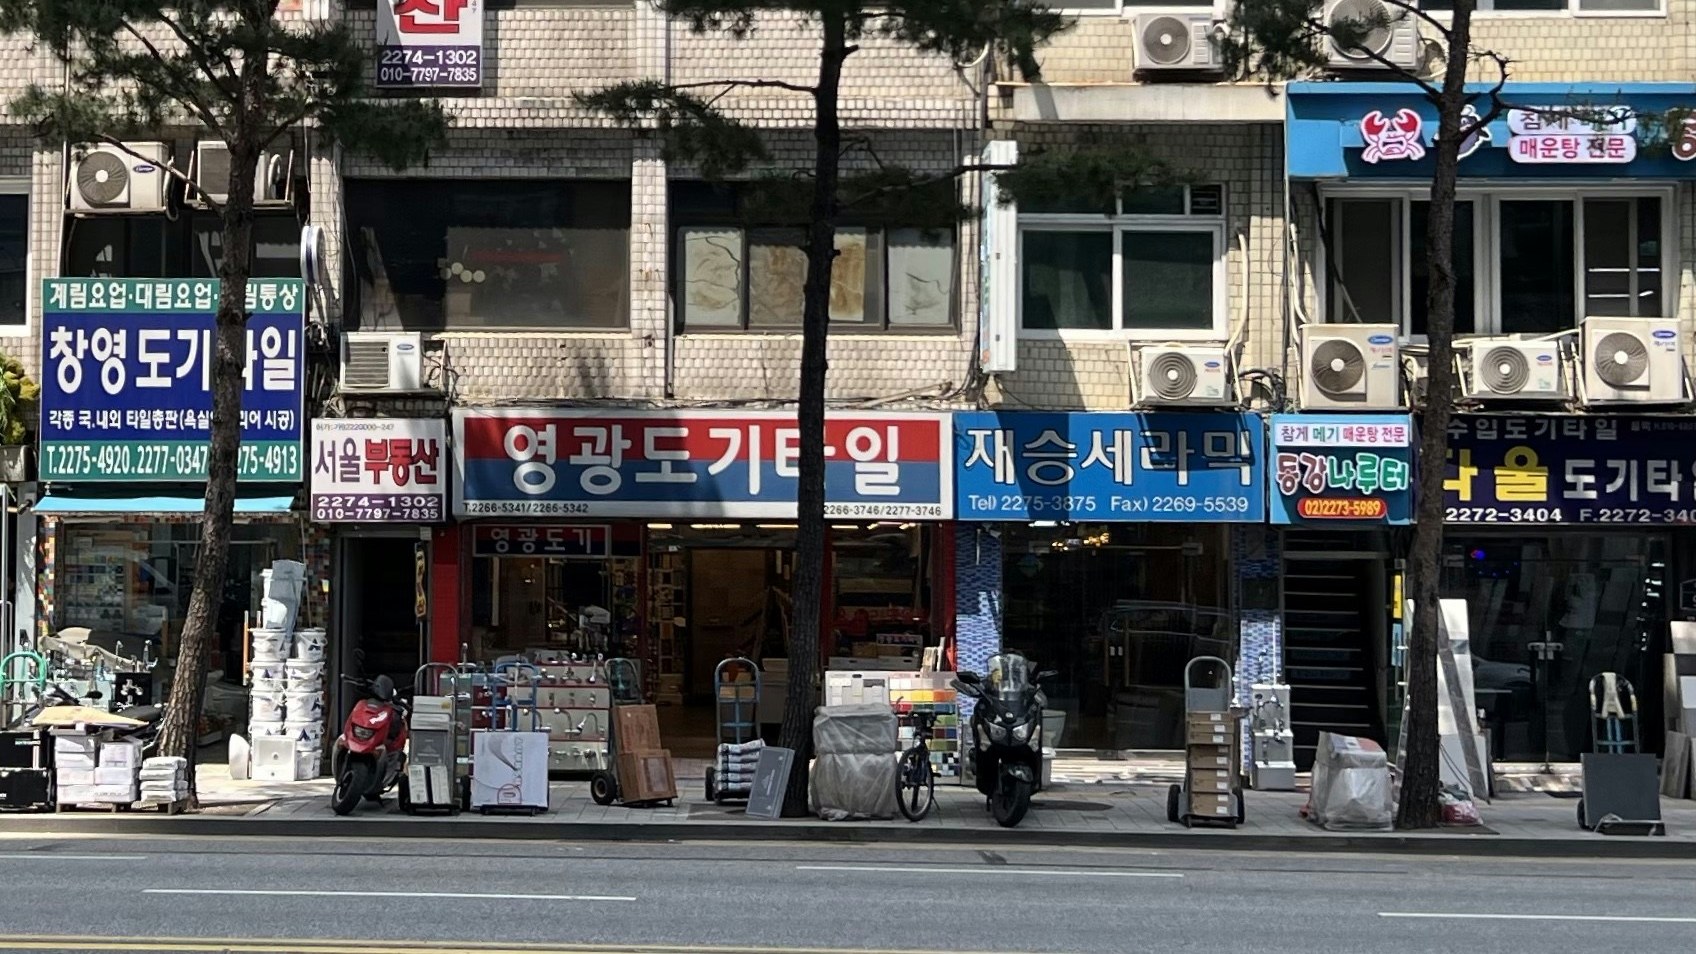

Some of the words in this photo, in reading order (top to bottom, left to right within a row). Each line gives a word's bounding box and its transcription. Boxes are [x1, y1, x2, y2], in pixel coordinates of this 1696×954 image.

[381, 49, 477, 65] 2274-1302
[380, 67, 477, 82] 010-7797-7835
[1519, 137, 1580, 159] 매운탕
[1586, 137, 1626, 159] 전문
[49, 409, 75, 430] 각종
[265, 410, 294, 431] 시공)
[1281, 425, 1308, 442] 참게
[1313, 425, 1339, 442] 메기
[1343, 425, 1378, 443] 매운탕
[1381, 425, 1405, 443] 전문
[504, 423, 901, 495] 영광도기타일
[964, 428, 1252, 486] 재승세라믹
[317, 496, 439, 507] 2274-1302
[1000, 495, 1096, 512] 2275-3875
[1152, 495, 1249, 512] 2269-5539
[1304, 499, 1381, 515] 02)2273-5989
[317, 508, 439, 519] 010-7797-7835
[490, 528, 592, 554] 영광도기
